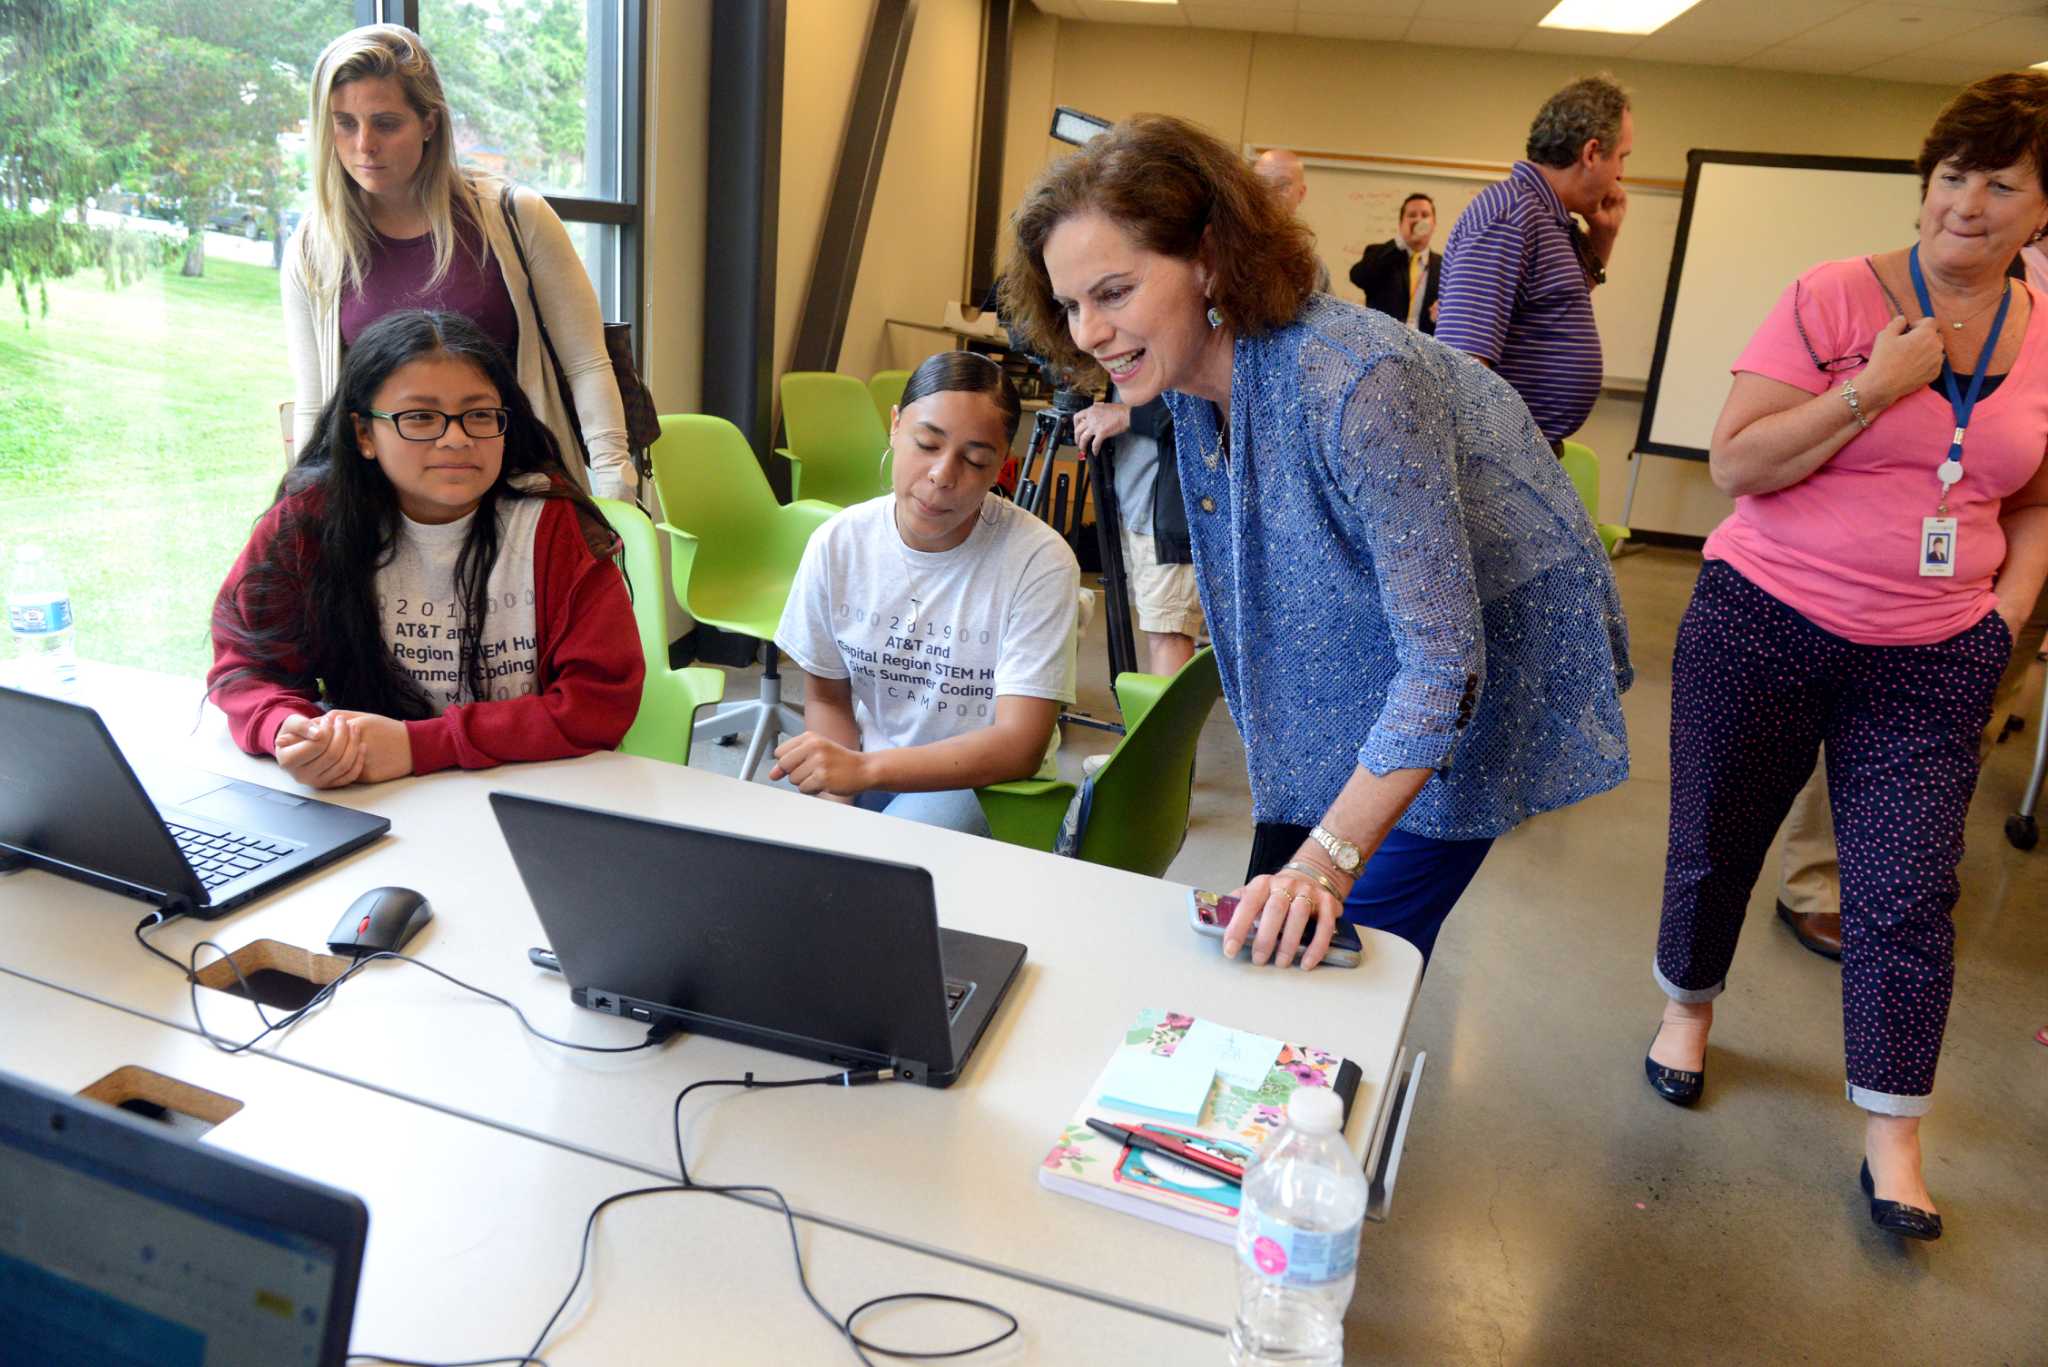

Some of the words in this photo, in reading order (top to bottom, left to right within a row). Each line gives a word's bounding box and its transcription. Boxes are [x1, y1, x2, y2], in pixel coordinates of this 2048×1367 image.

[395, 622, 442, 639] AT&T
[393, 643, 454, 664] Region
[461, 640, 507, 660] SEM
[885, 635, 924, 652] AT&T
[925, 643, 951, 659] and
[882, 653, 933, 671] Region
[935, 663, 975, 681] STEM
[849, 660, 877, 678] Girls
[880, 669, 937, 690] Summer
[939, 682, 995, 699] Coding
